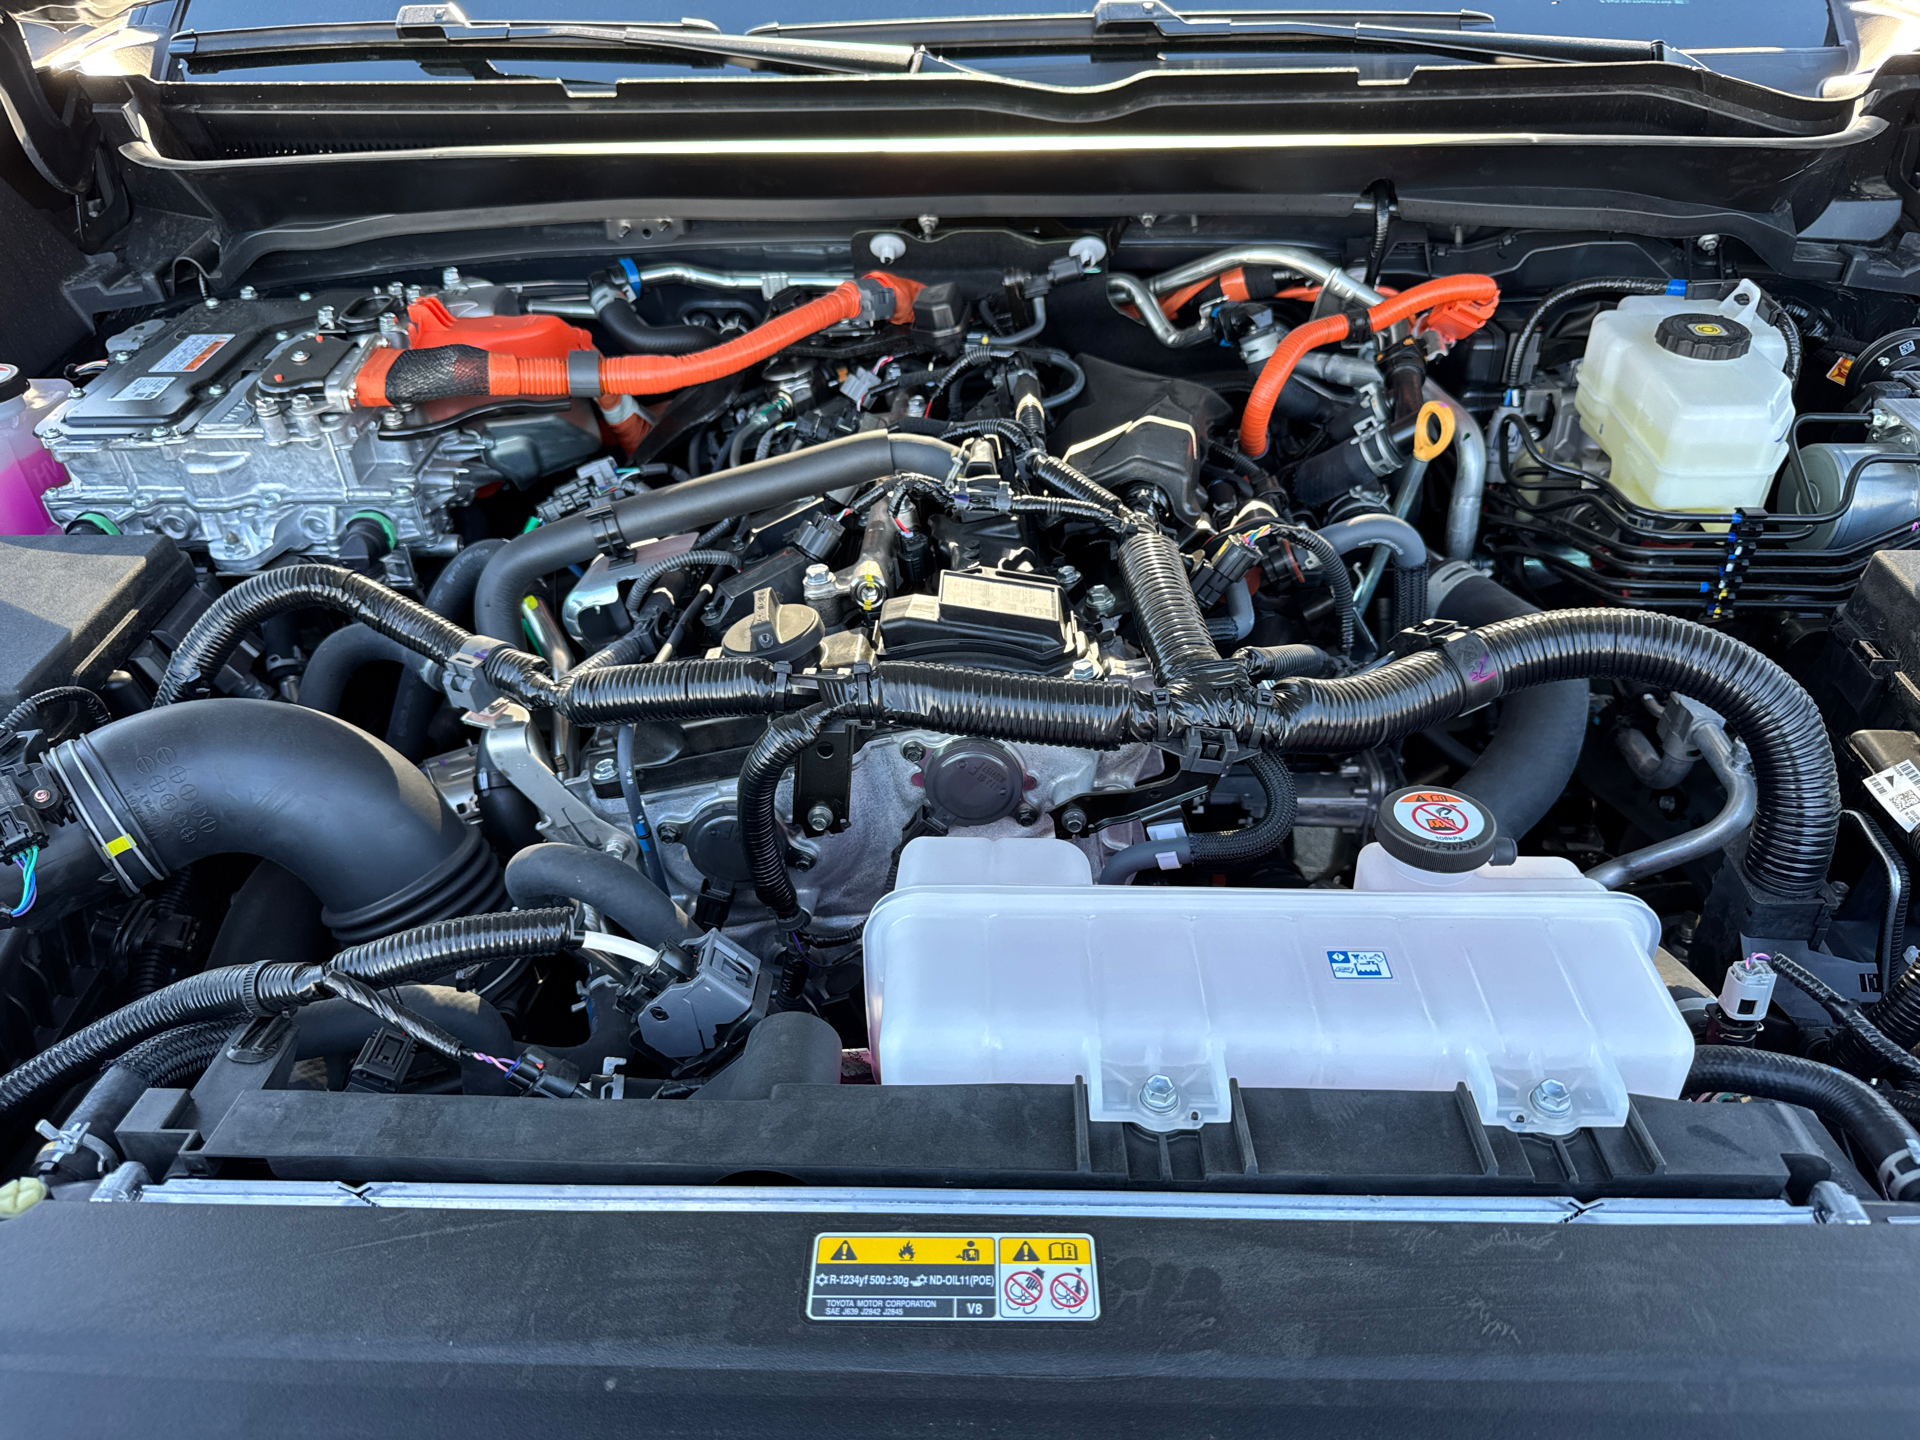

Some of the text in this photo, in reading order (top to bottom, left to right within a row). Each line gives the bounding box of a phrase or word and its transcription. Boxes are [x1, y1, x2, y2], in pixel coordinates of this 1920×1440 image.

[1424, 840, 1479, 851] DENSO
[829, 1274, 995, 1288] R-1234yf 500±30g ND-OIL11(POE)
[826, 1300, 937, 1308] TOYOTA MOTOR CORPORATION
[966, 1302, 983, 1315] V8
[825, 1308, 840, 1316] SAE
[842, 1308, 859, 1316] J639
